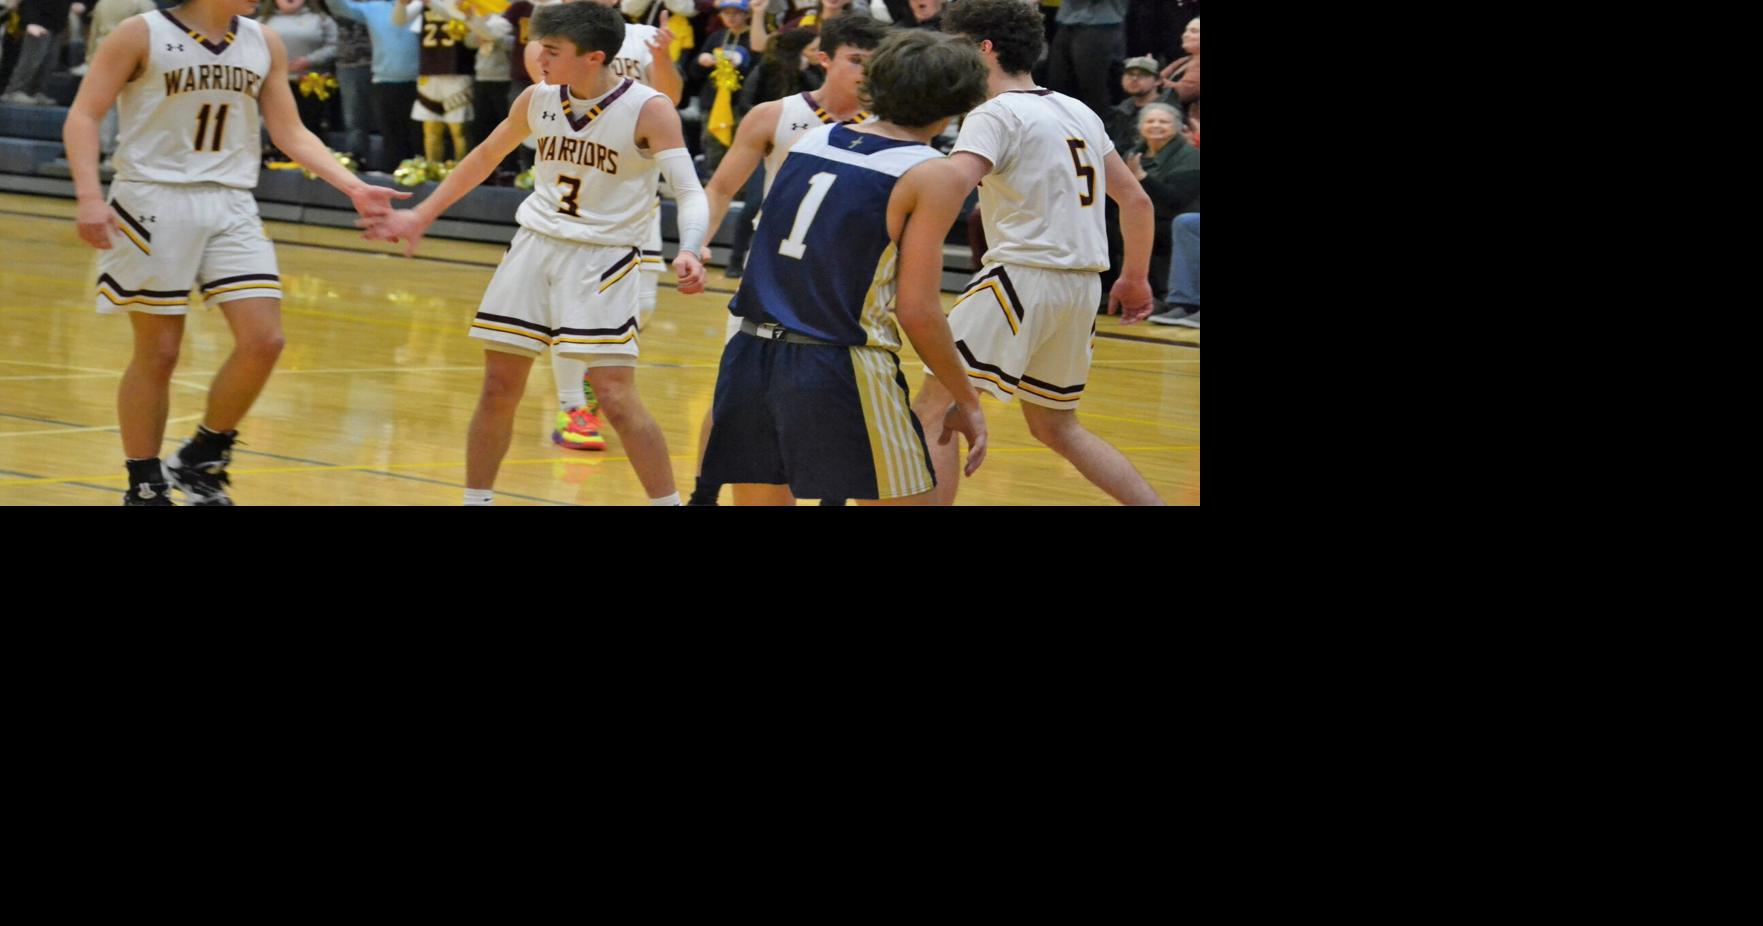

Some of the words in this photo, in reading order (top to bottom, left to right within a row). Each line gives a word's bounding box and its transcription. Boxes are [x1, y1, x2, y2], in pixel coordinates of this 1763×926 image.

[194, 103, 229, 153] 11
[556, 173, 582, 218] 3
[1066, 137, 1097, 208] 5
[778, 171, 838, 261] 1
